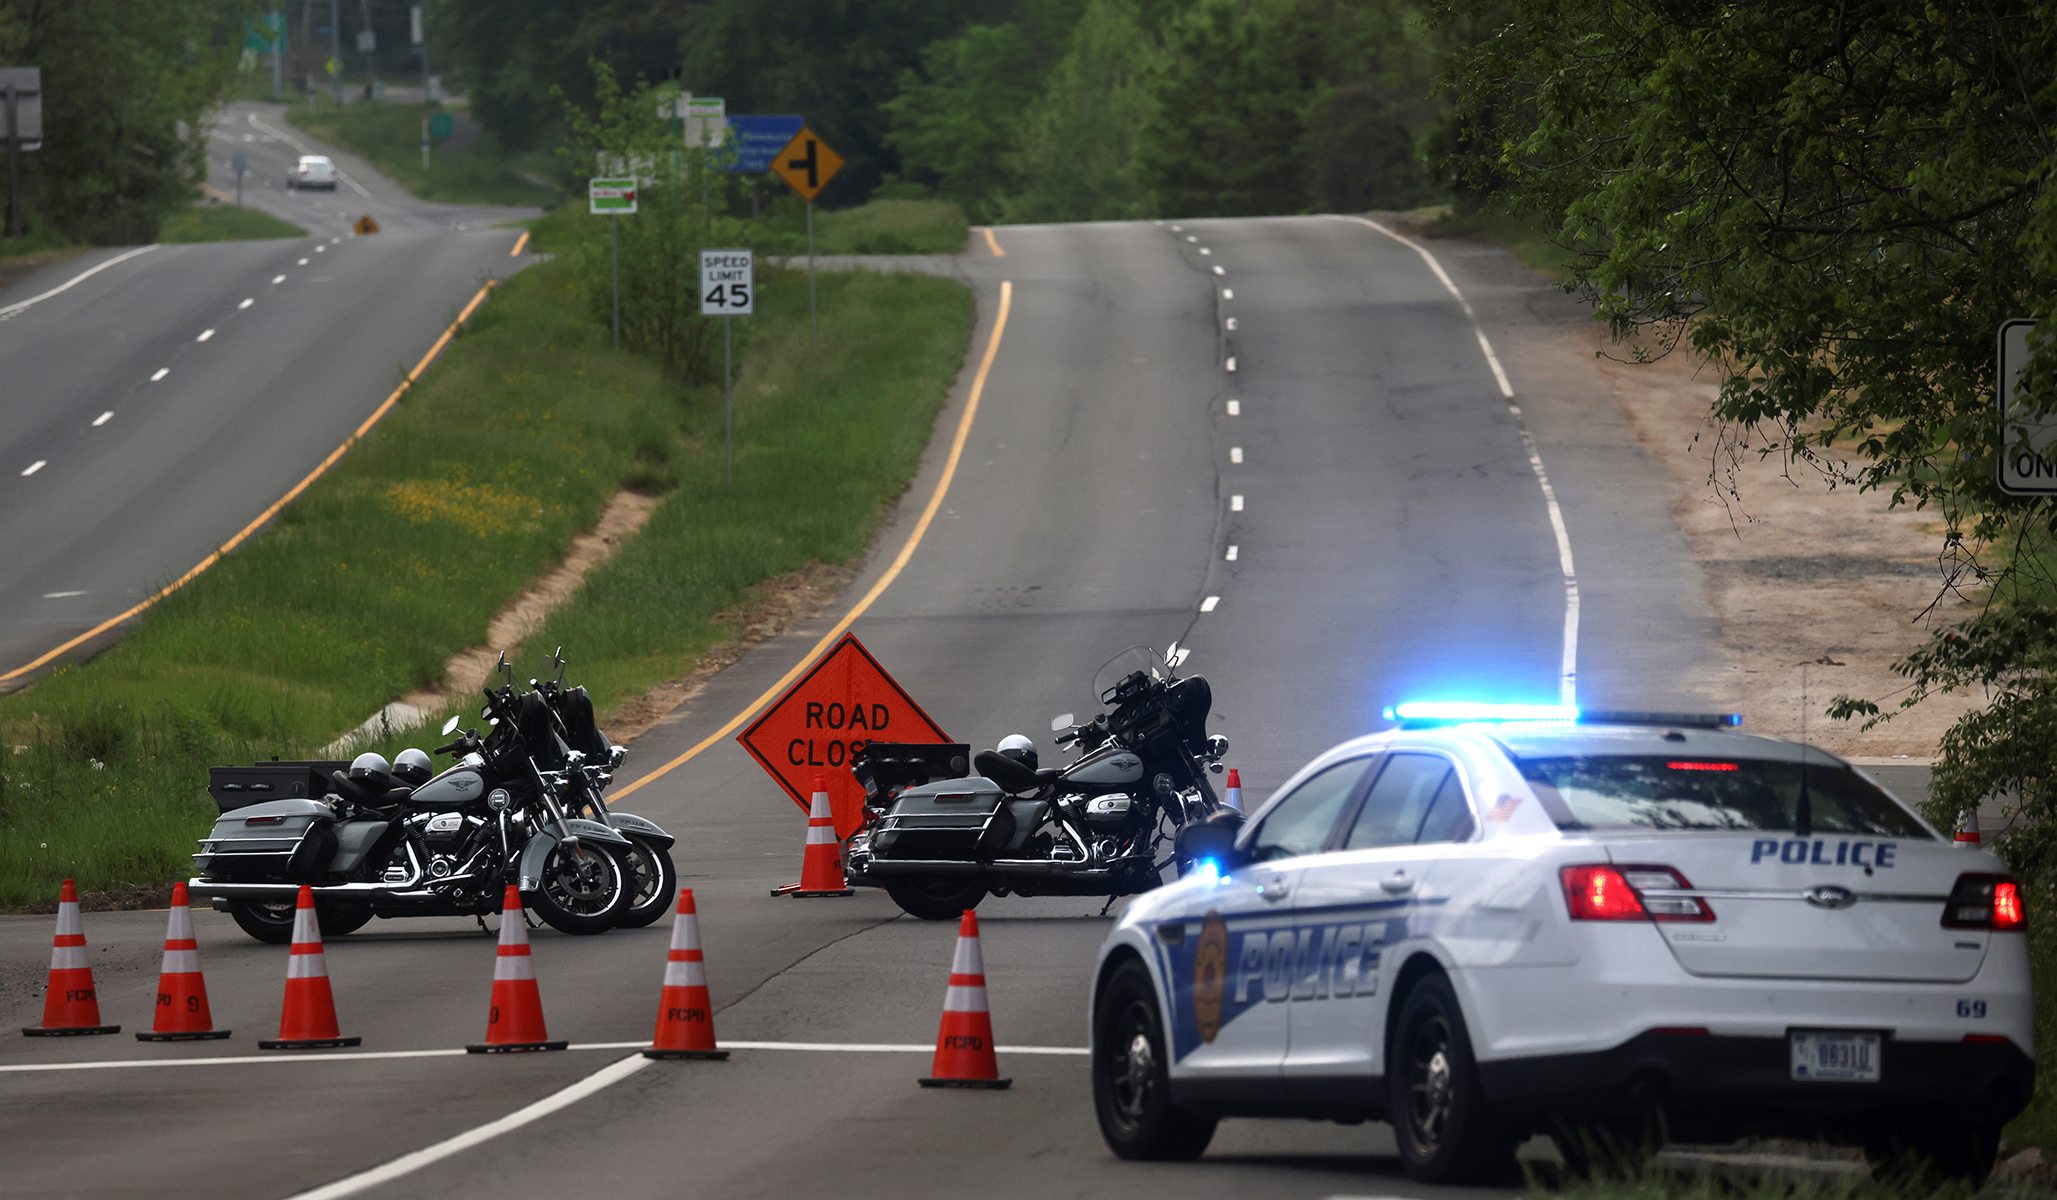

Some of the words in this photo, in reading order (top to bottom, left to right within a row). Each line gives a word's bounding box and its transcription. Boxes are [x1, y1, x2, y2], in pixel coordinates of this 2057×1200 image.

[705, 256, 750, 268] SPEED
[709, 271, 743, 281] LIMIT
[705, 284, 749, 307] 45
[2016, 453, 2057, 478] ON
[806, 702, 890, 730] ROAD
[788, 738, 867, 768] CLOS
[1751, 840, 1897, 868] POLICE
[1234, 922, 1387, 1003] POLICE
[187, 995, 200, 1013] 9
[1957, 999, 1987, 1018] 69
[668, 1008, 705, 1022] FCPD
[944, 1036, 983, 1050] FCPD
